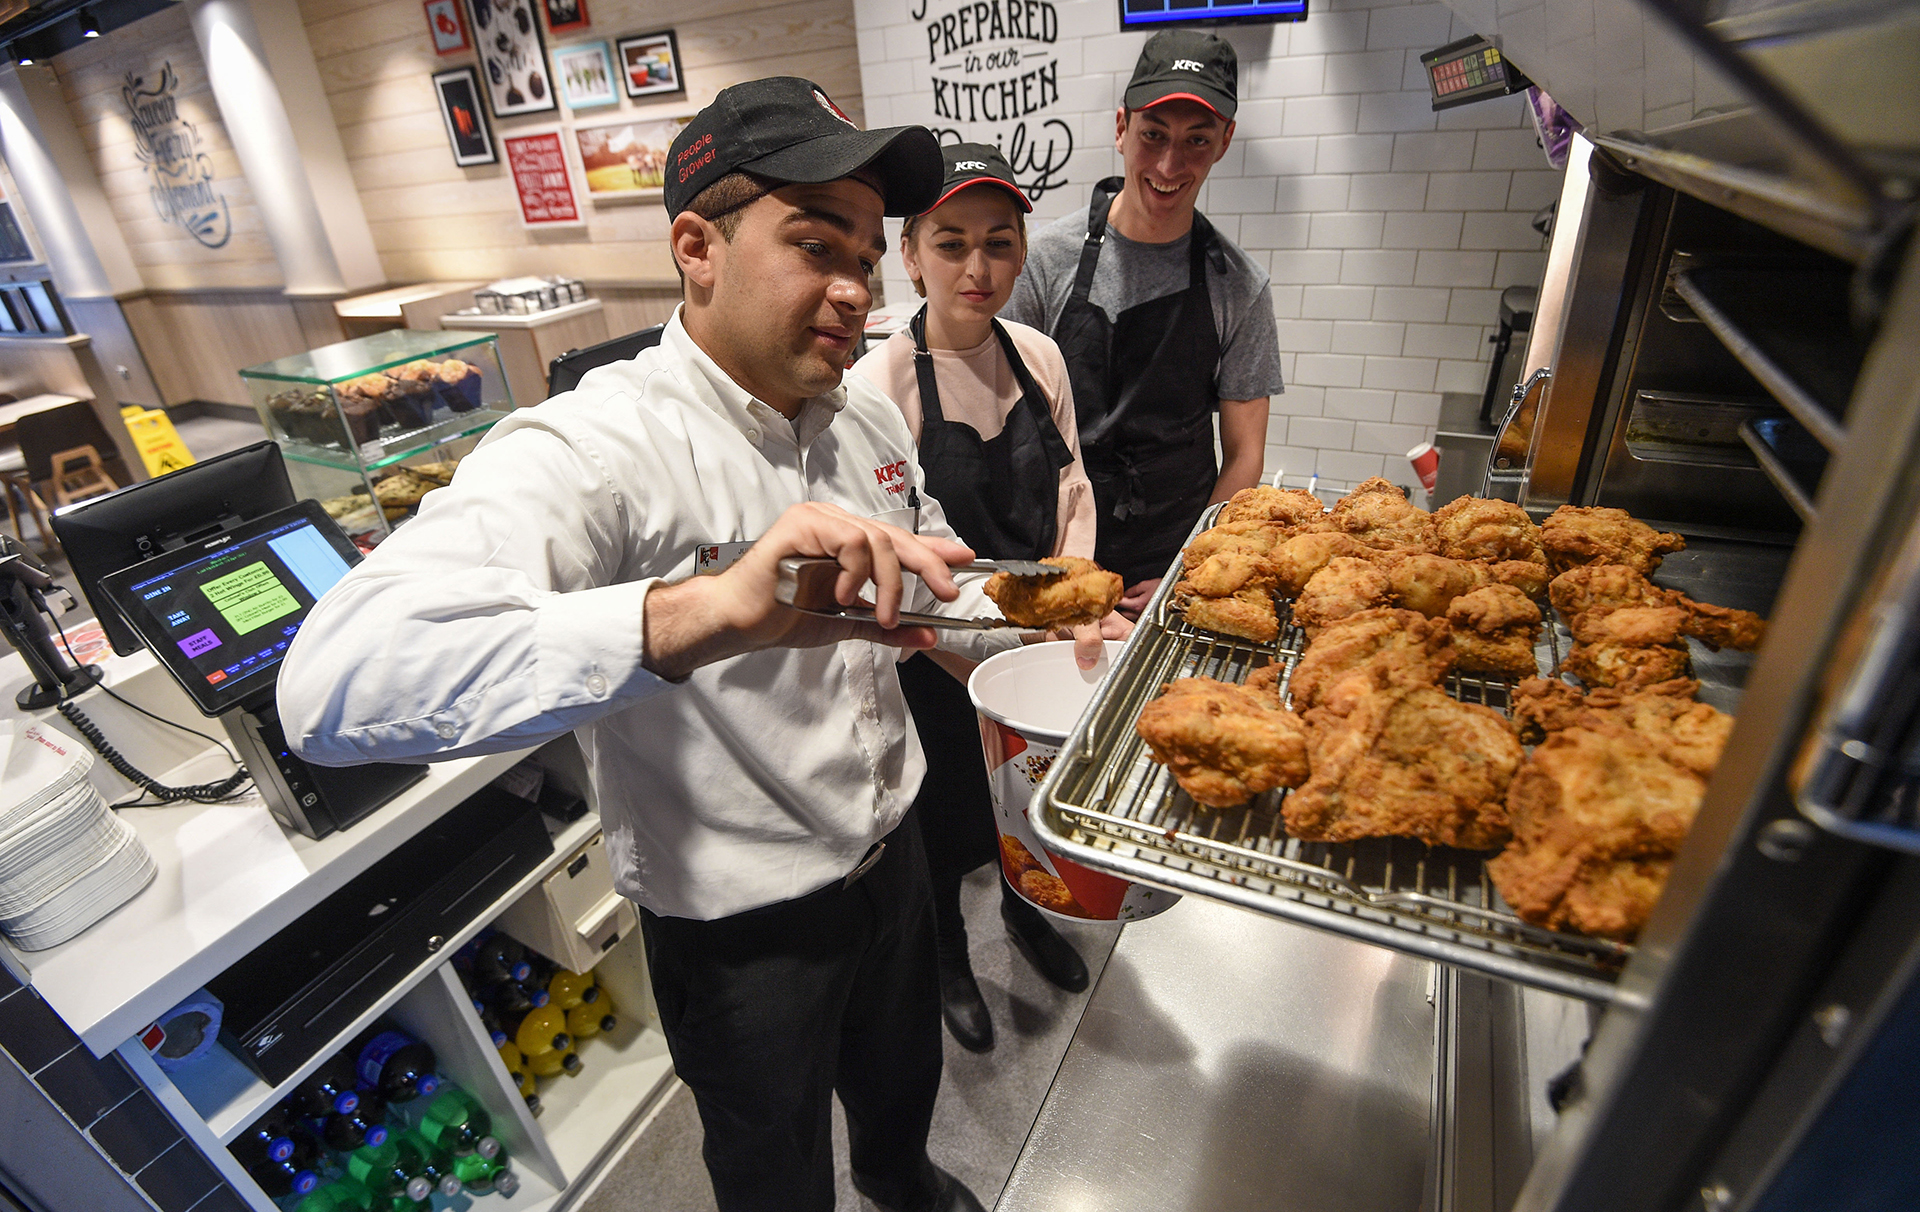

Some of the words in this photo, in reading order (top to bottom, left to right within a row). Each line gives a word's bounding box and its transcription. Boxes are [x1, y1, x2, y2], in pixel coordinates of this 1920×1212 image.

[927, 0, 1058, 64] PREPARED
[965, 51, 982, 73] in
[986, 48, 1020, 70] our
[1171, 59, 1204, 72] KFC
[931, 59, 1059, 122] KITCHEN
[677, 133, 713, 166] People
[678, 148, 716, 183] Grower
[954, 160, 988, 172] KFC
[873, 460, 907, 485] KFC
[143, 588, 162, 600] DINE
[161, 584, 172, 593] IN
[167, 610, 186, 621] TAKE
[171, 615, 191, 628] AWAY
[188, 636, 207, 648] STAFF
[192, 640, 214, 652] MEALS
